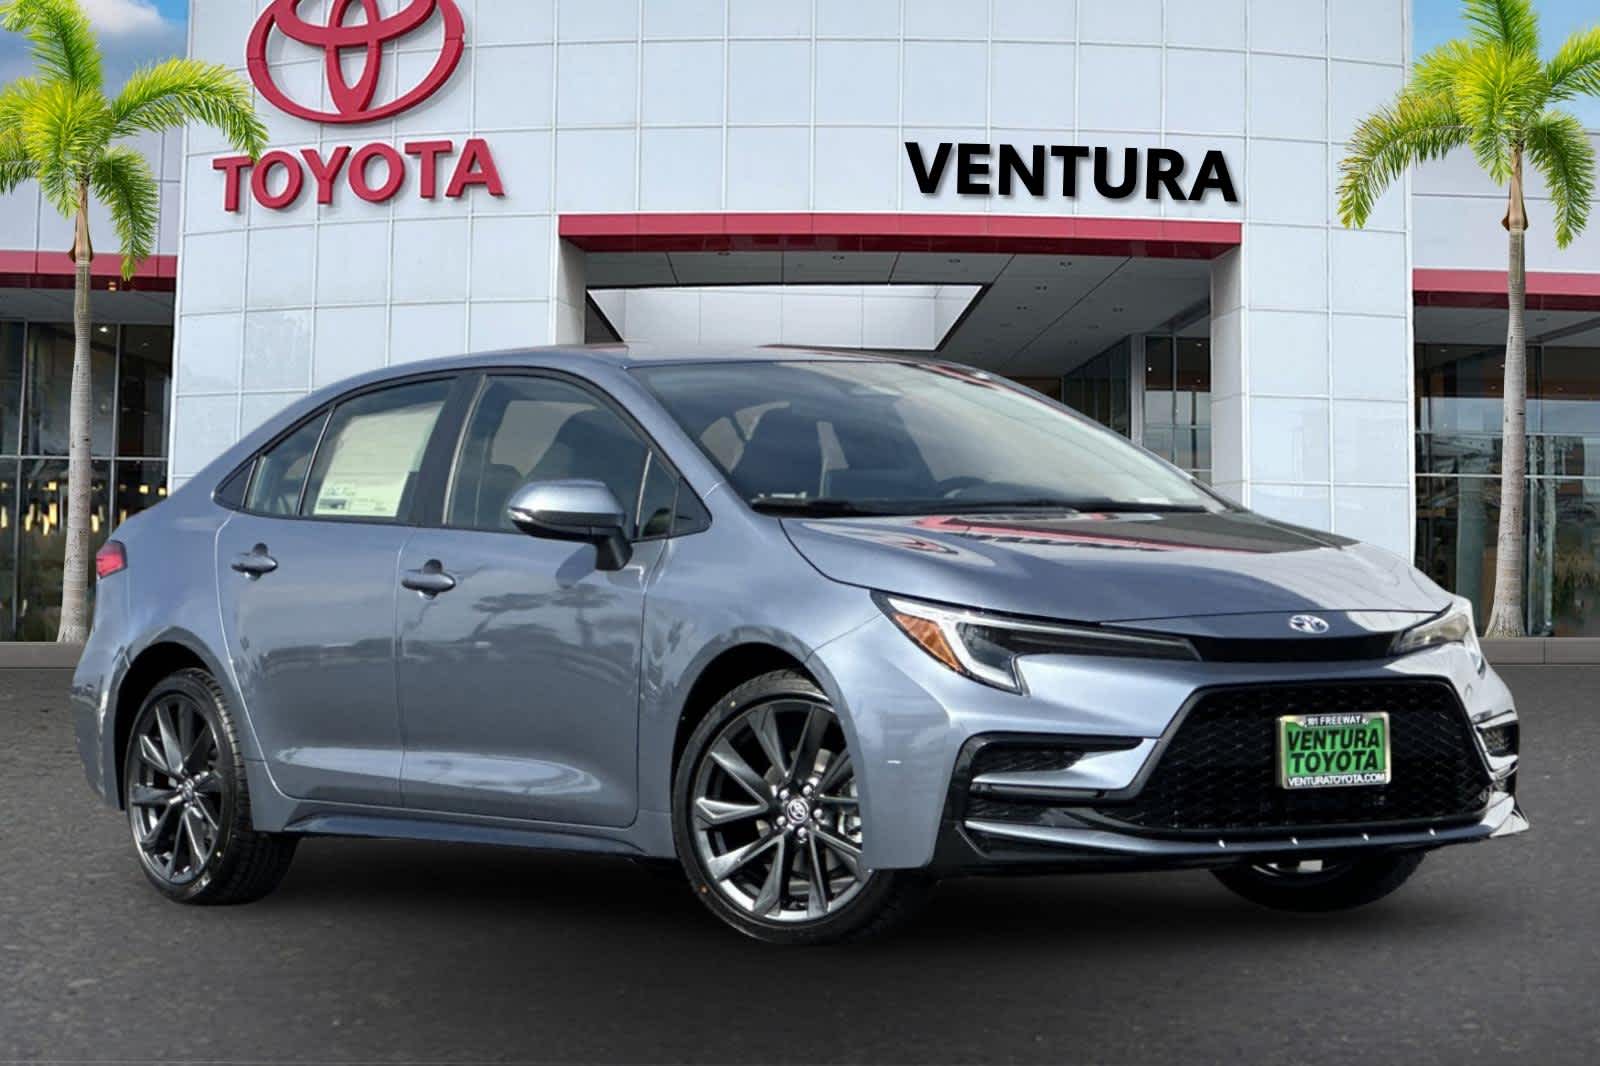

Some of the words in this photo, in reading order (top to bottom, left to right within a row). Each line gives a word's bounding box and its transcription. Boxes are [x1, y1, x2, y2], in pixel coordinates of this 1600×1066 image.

[212, 138, 505, 212] TOYOTA
[904, 141, 1238, 203] VENTURA
[1319, 715, 1361, 726] FREEWAY
[1287, 728, 1381, 751] VENTURA
[1290, 750, 1378, 773] TOYOTA
[1287, 773, 1385, 787] VENTURATOYOTA.COM
